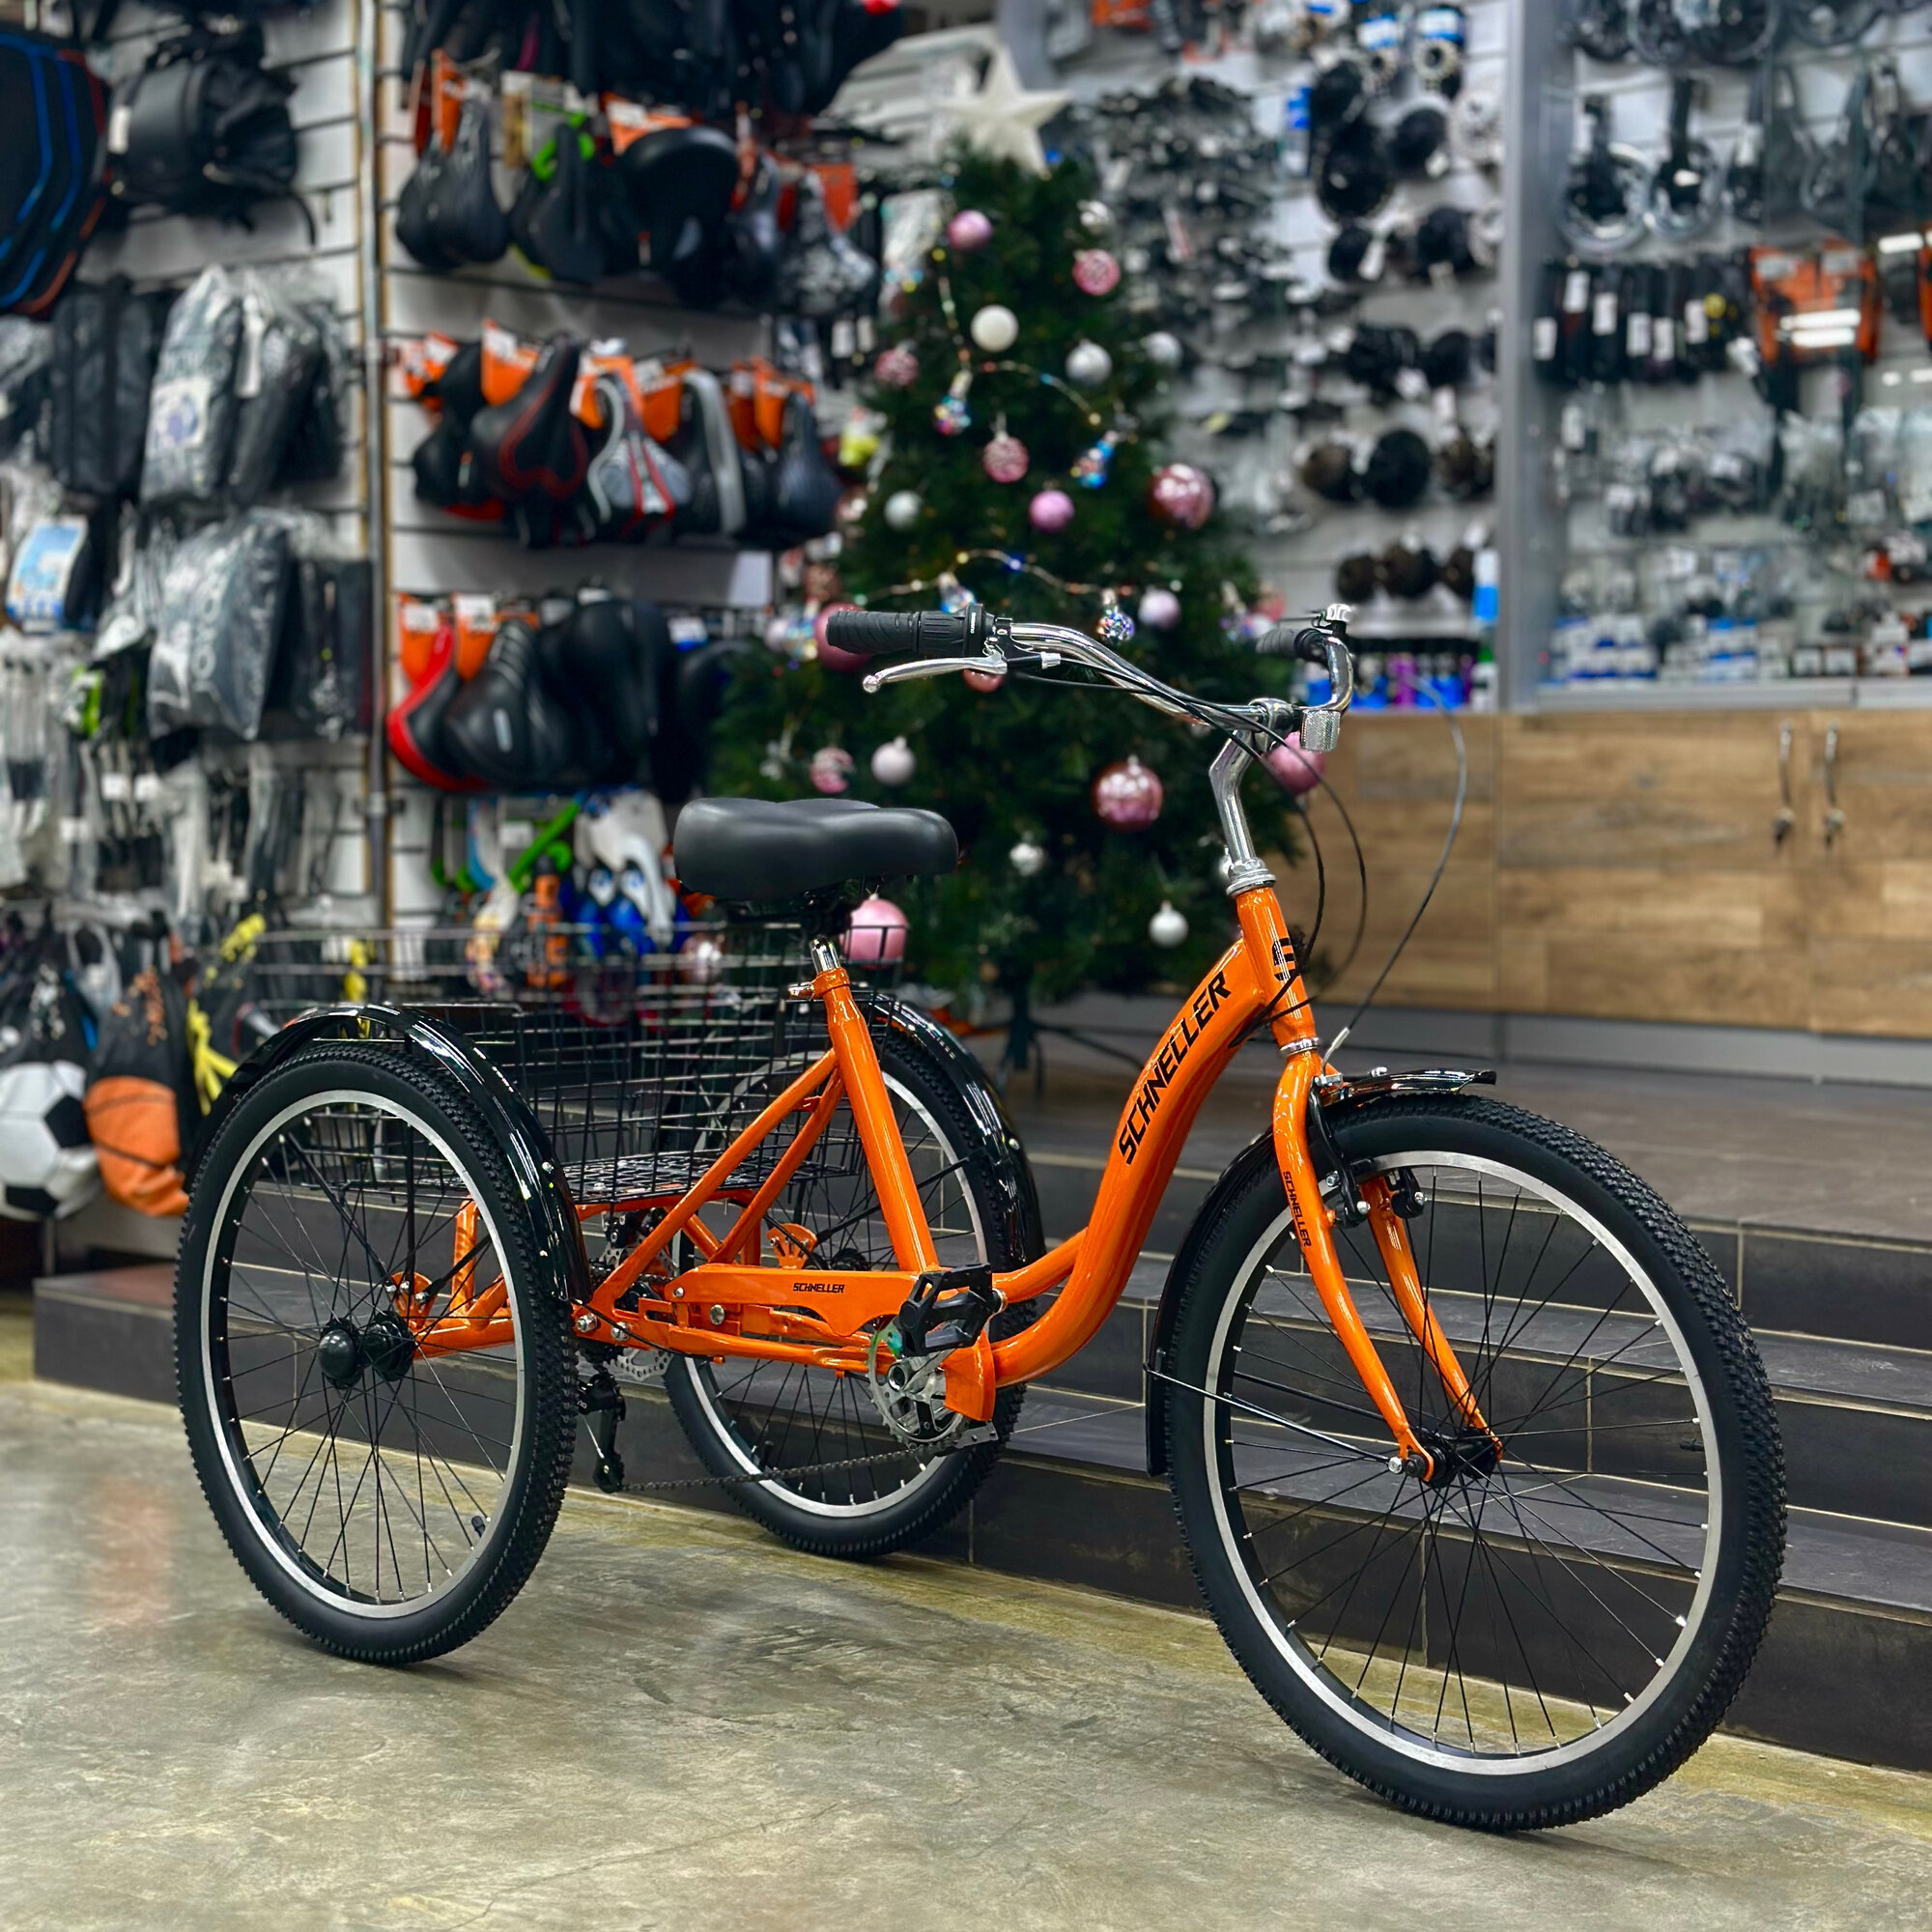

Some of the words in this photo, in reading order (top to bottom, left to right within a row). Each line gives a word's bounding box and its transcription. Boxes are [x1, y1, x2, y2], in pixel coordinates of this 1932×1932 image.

[1119, 970, 1232, 1166] SCHNELLER
[1284, 1172, 1311, 1247] SCHNELLER
[793, 1282, 845, 1293] SCHNELLER
